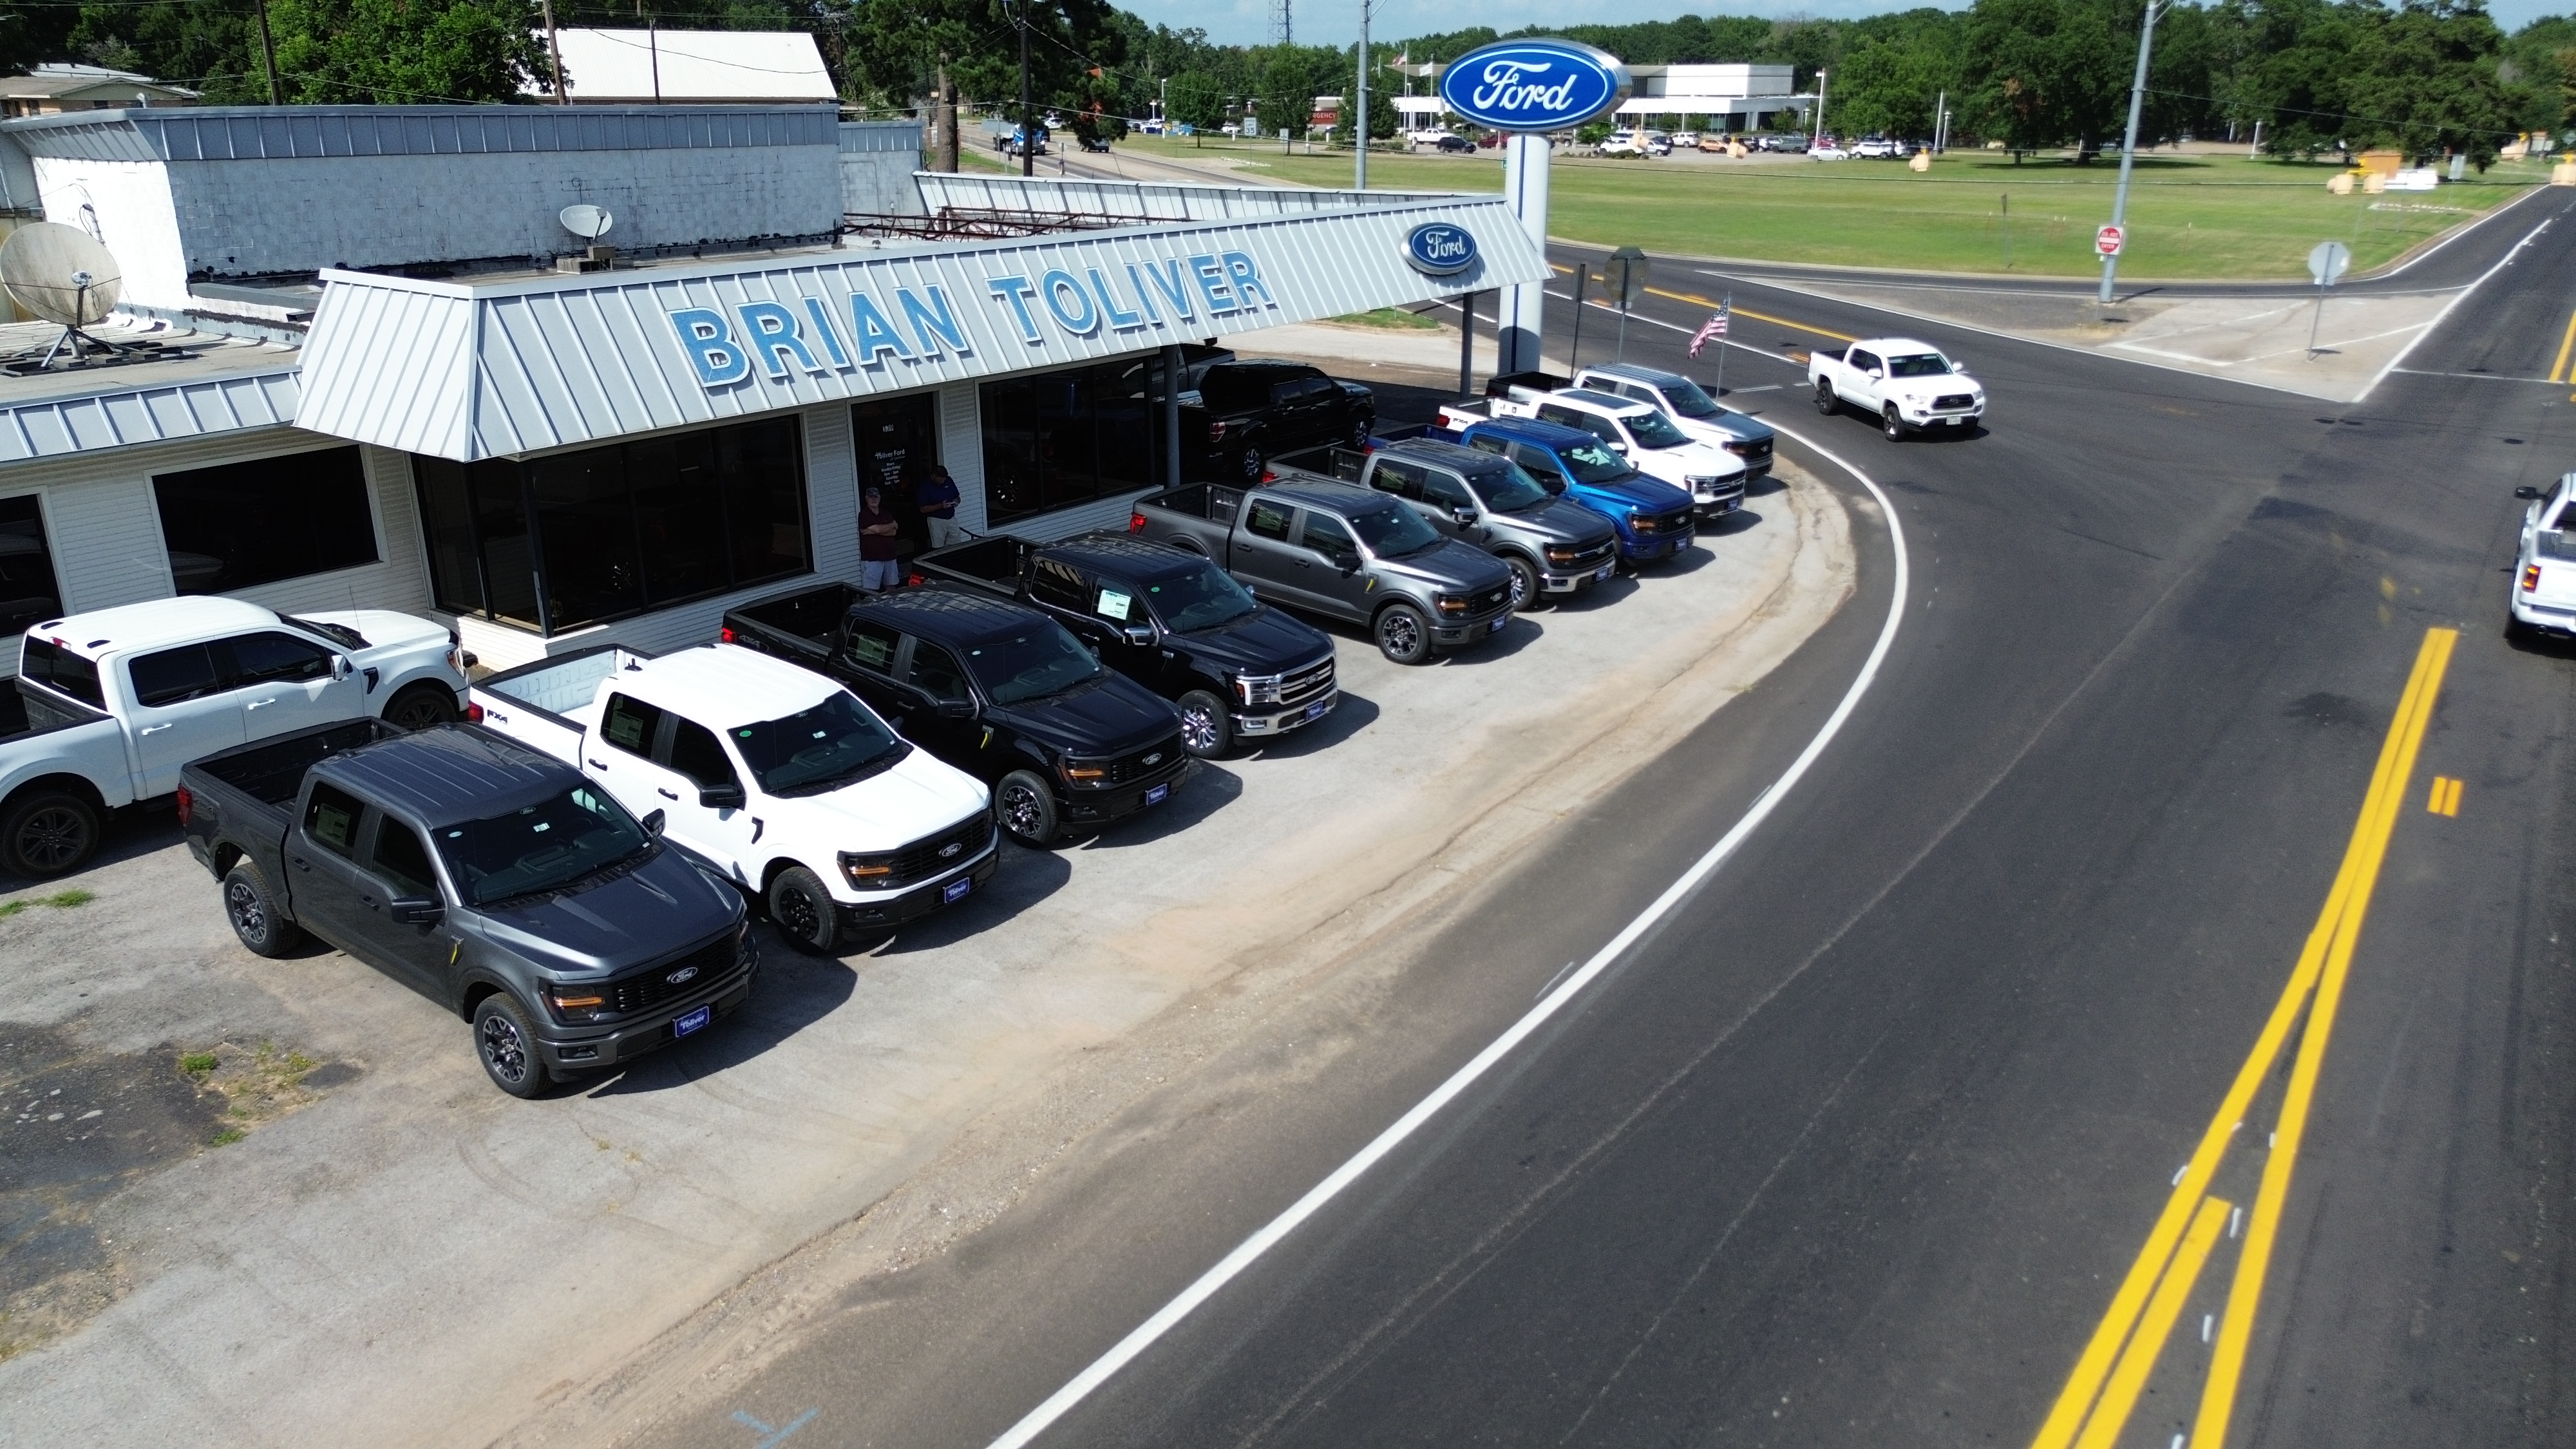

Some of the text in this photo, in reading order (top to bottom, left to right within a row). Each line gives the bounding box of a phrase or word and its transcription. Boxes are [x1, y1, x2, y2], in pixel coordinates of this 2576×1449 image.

[1473, 61, 1577, 111] Ford
[1426, 231, 1465, 259] Ford
[665, 250, 1275, 388] BRIAN TOLIVER
[875, 451, 893, 460] Toliver
[681, 1015, 705, 1029] Toliver
